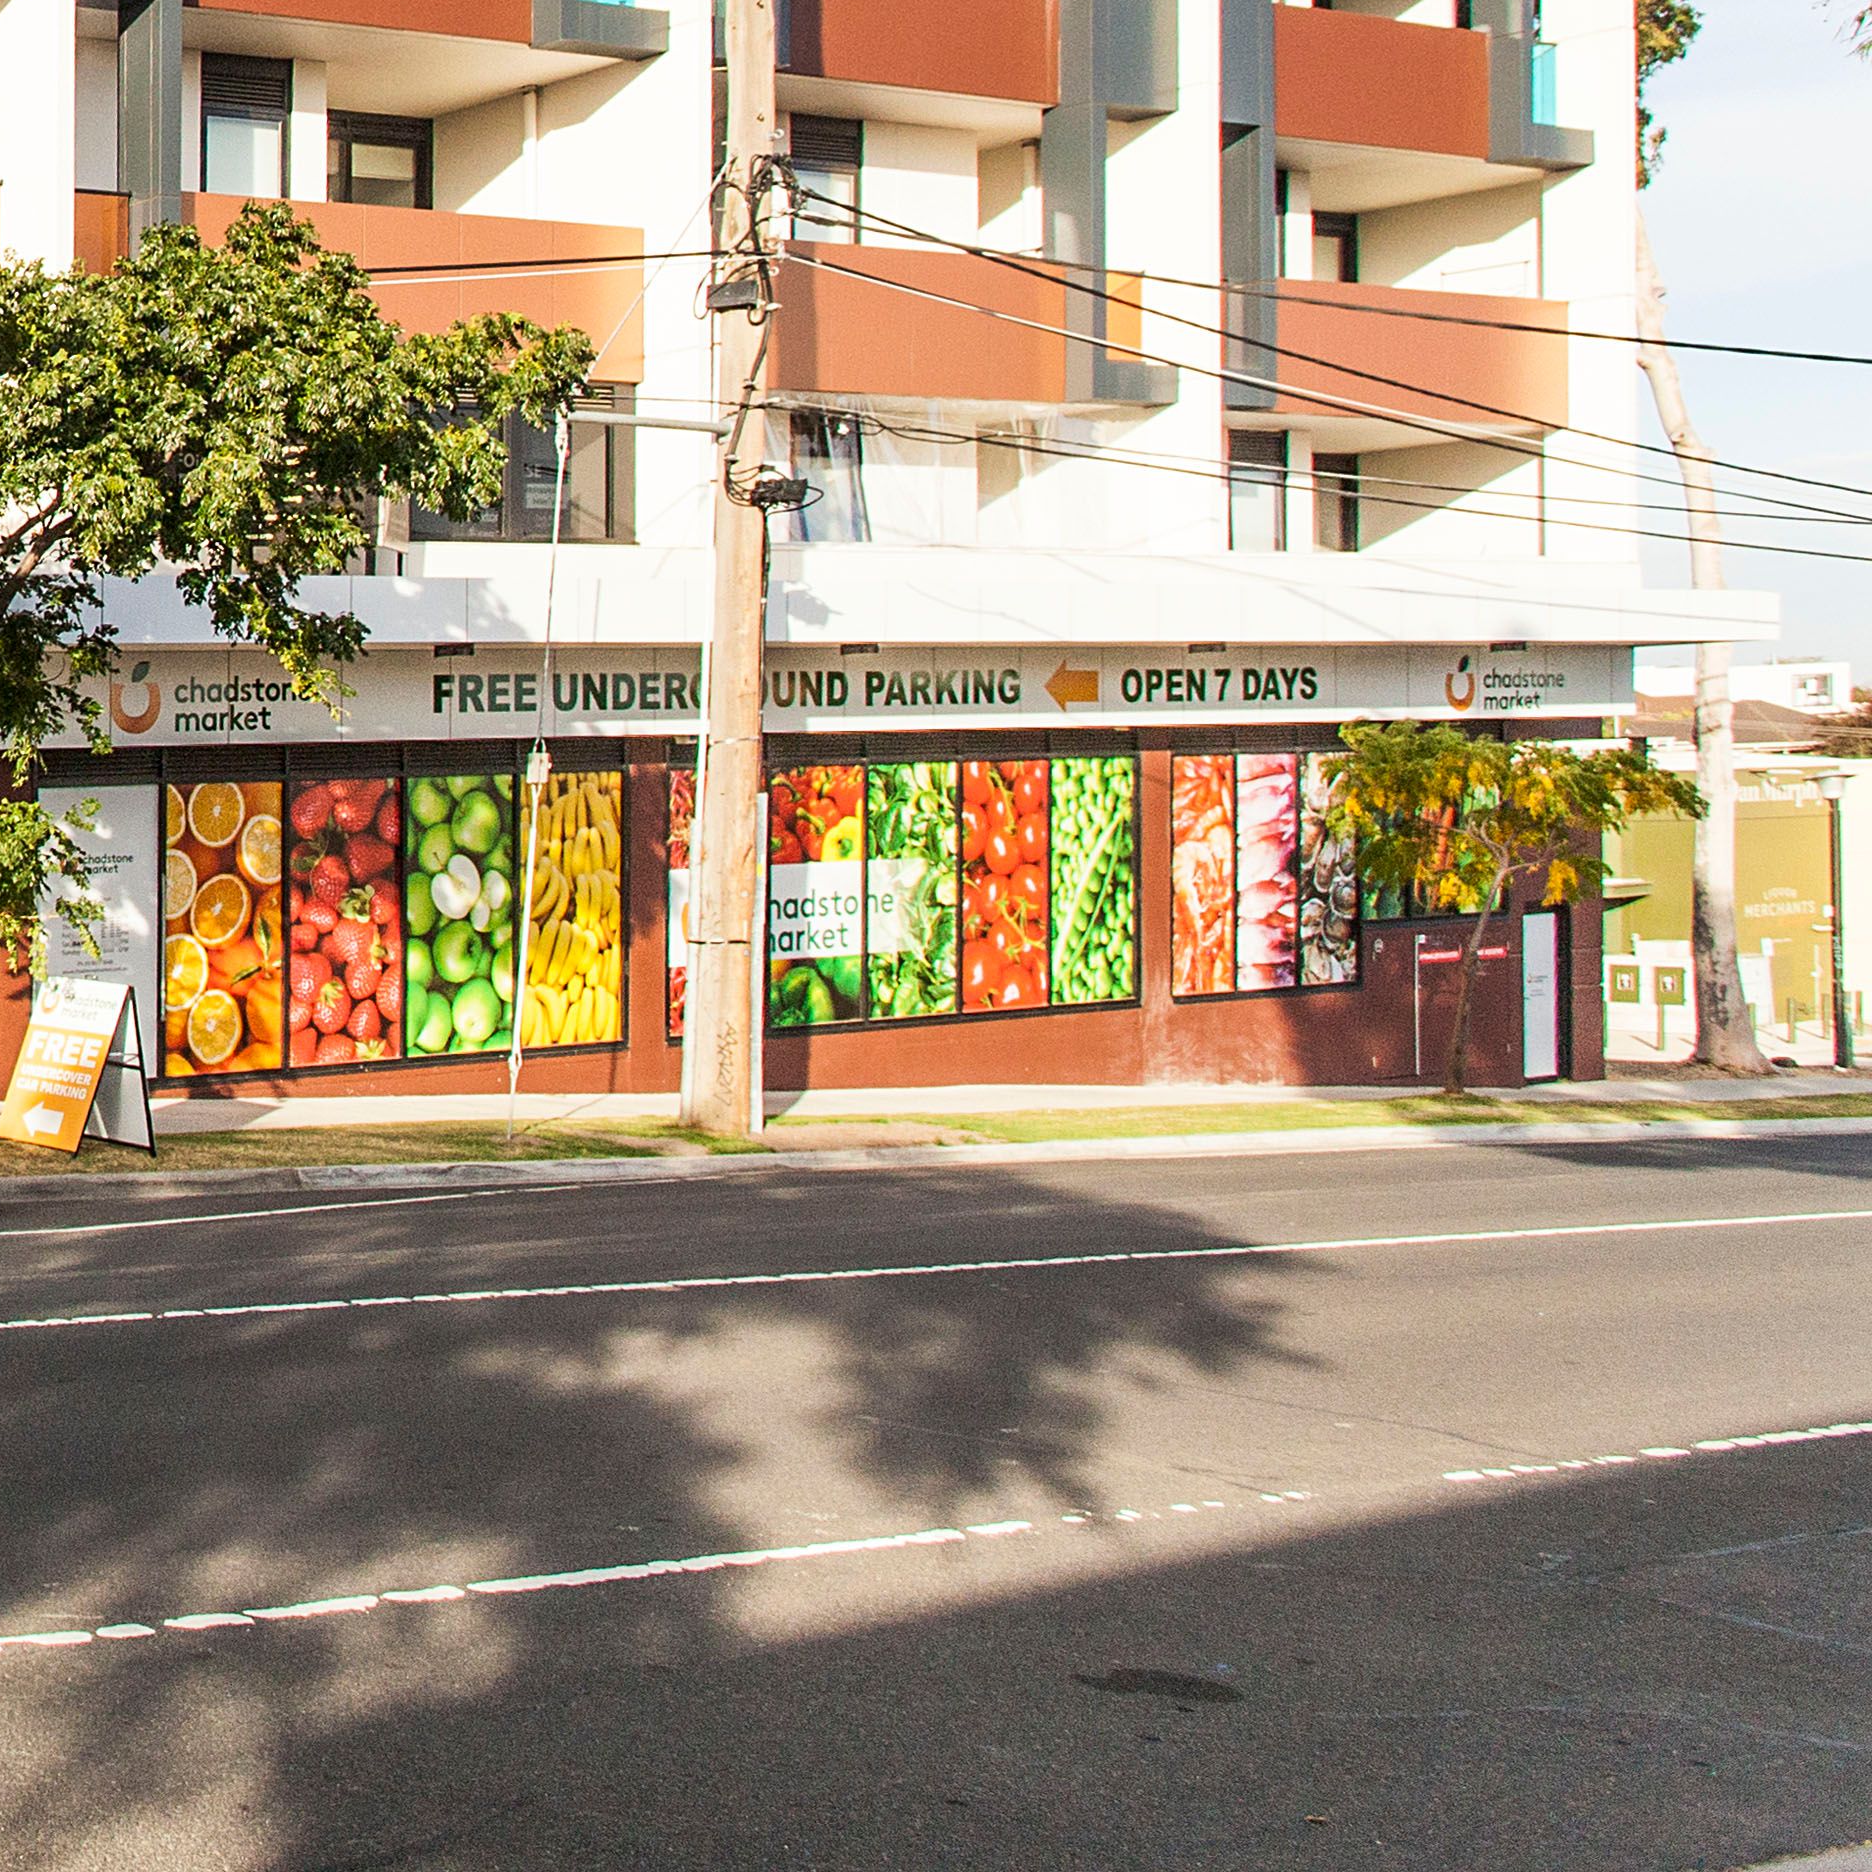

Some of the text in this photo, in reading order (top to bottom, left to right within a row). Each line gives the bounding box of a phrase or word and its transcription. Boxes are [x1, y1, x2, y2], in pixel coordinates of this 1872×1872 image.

[1121, 667, 1318, 703] OPEN 7 DAYS
[1483, 667, 1565, 688] chadstone
[433, 669, 1021, 713] FREE UNDERUND PARKING
[1483, 690, 1541, 710] market
[175, 704, 271, 732] market
[84, 864, 118, 874] arket
[770, 889, 894, 920] adstone
[1744, 900, 1816, 918] MERCHANTS
[26, 1030, 102, 1068] FREE
[20, 1064, 92, 1086] UNDERCOVER
[16, 1077, 87, 1100] CAR PARKING
